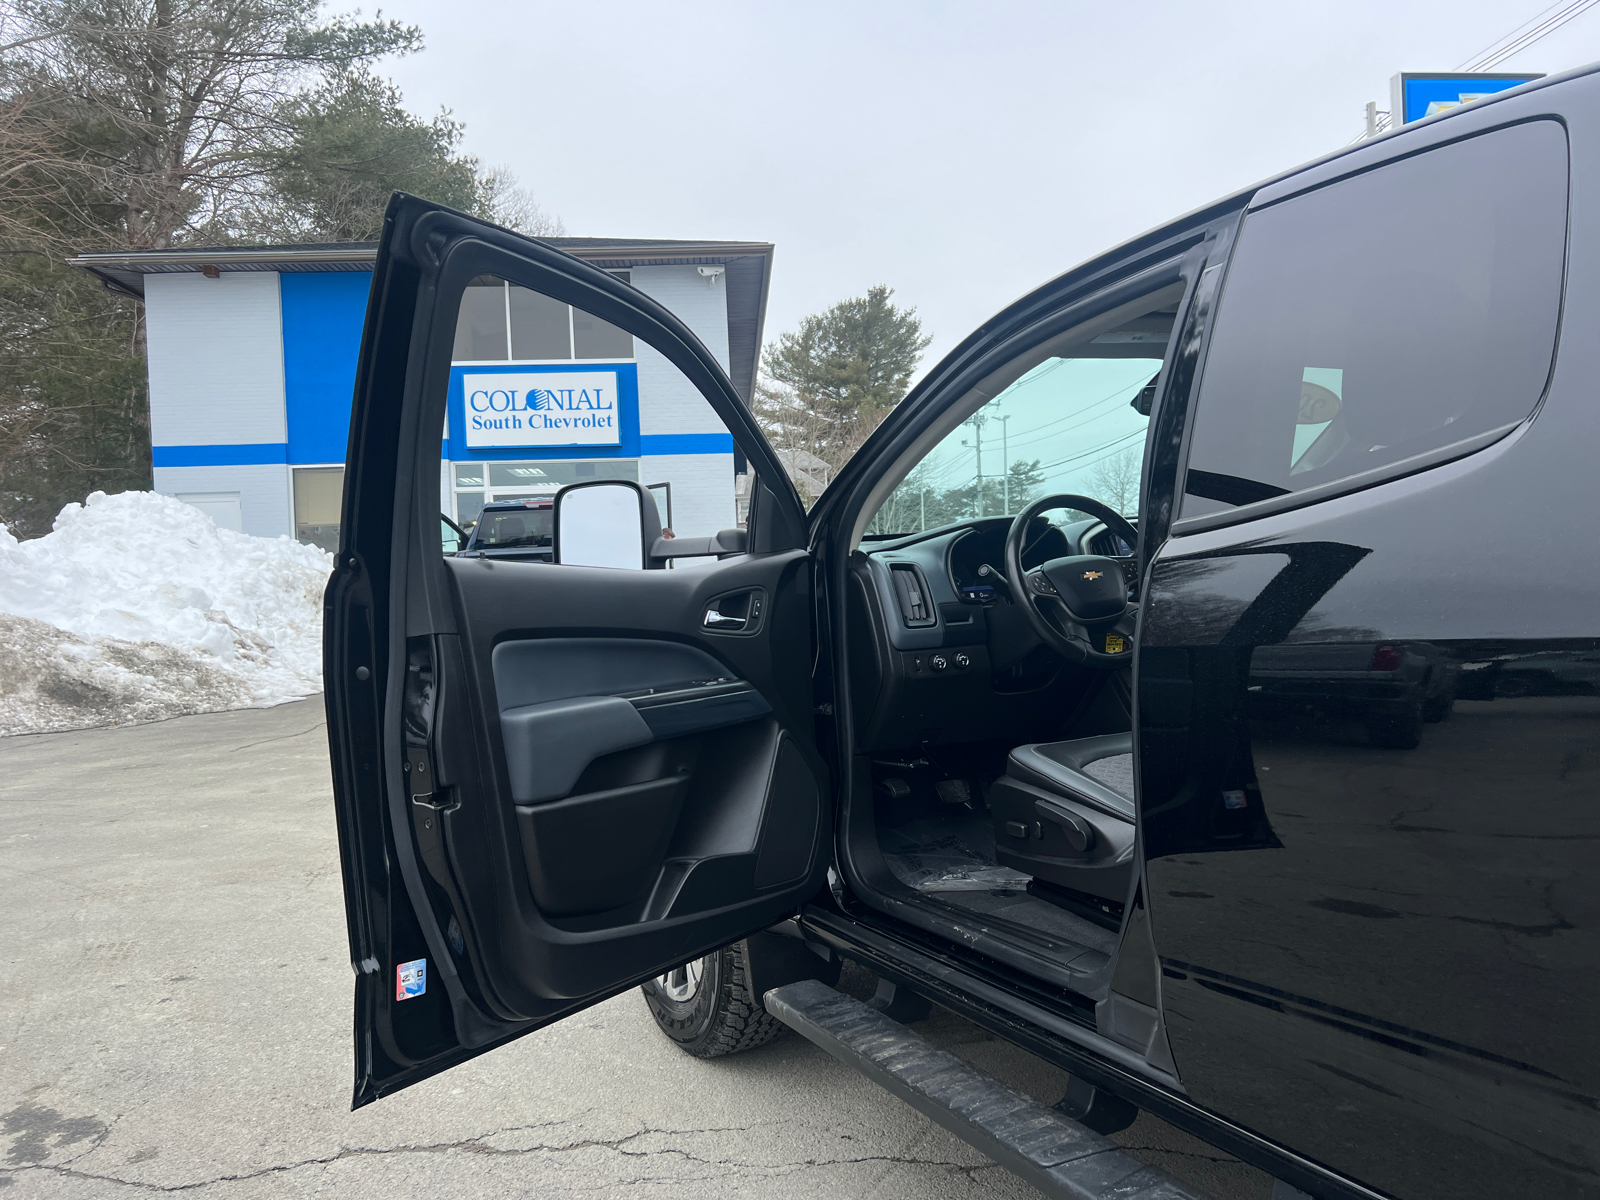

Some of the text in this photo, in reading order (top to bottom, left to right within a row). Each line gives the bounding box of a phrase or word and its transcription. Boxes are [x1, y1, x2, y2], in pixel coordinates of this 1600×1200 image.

[470, 388, 613, 412] COLONIAL
[472, 413, 613, 430] South Chevrolet
